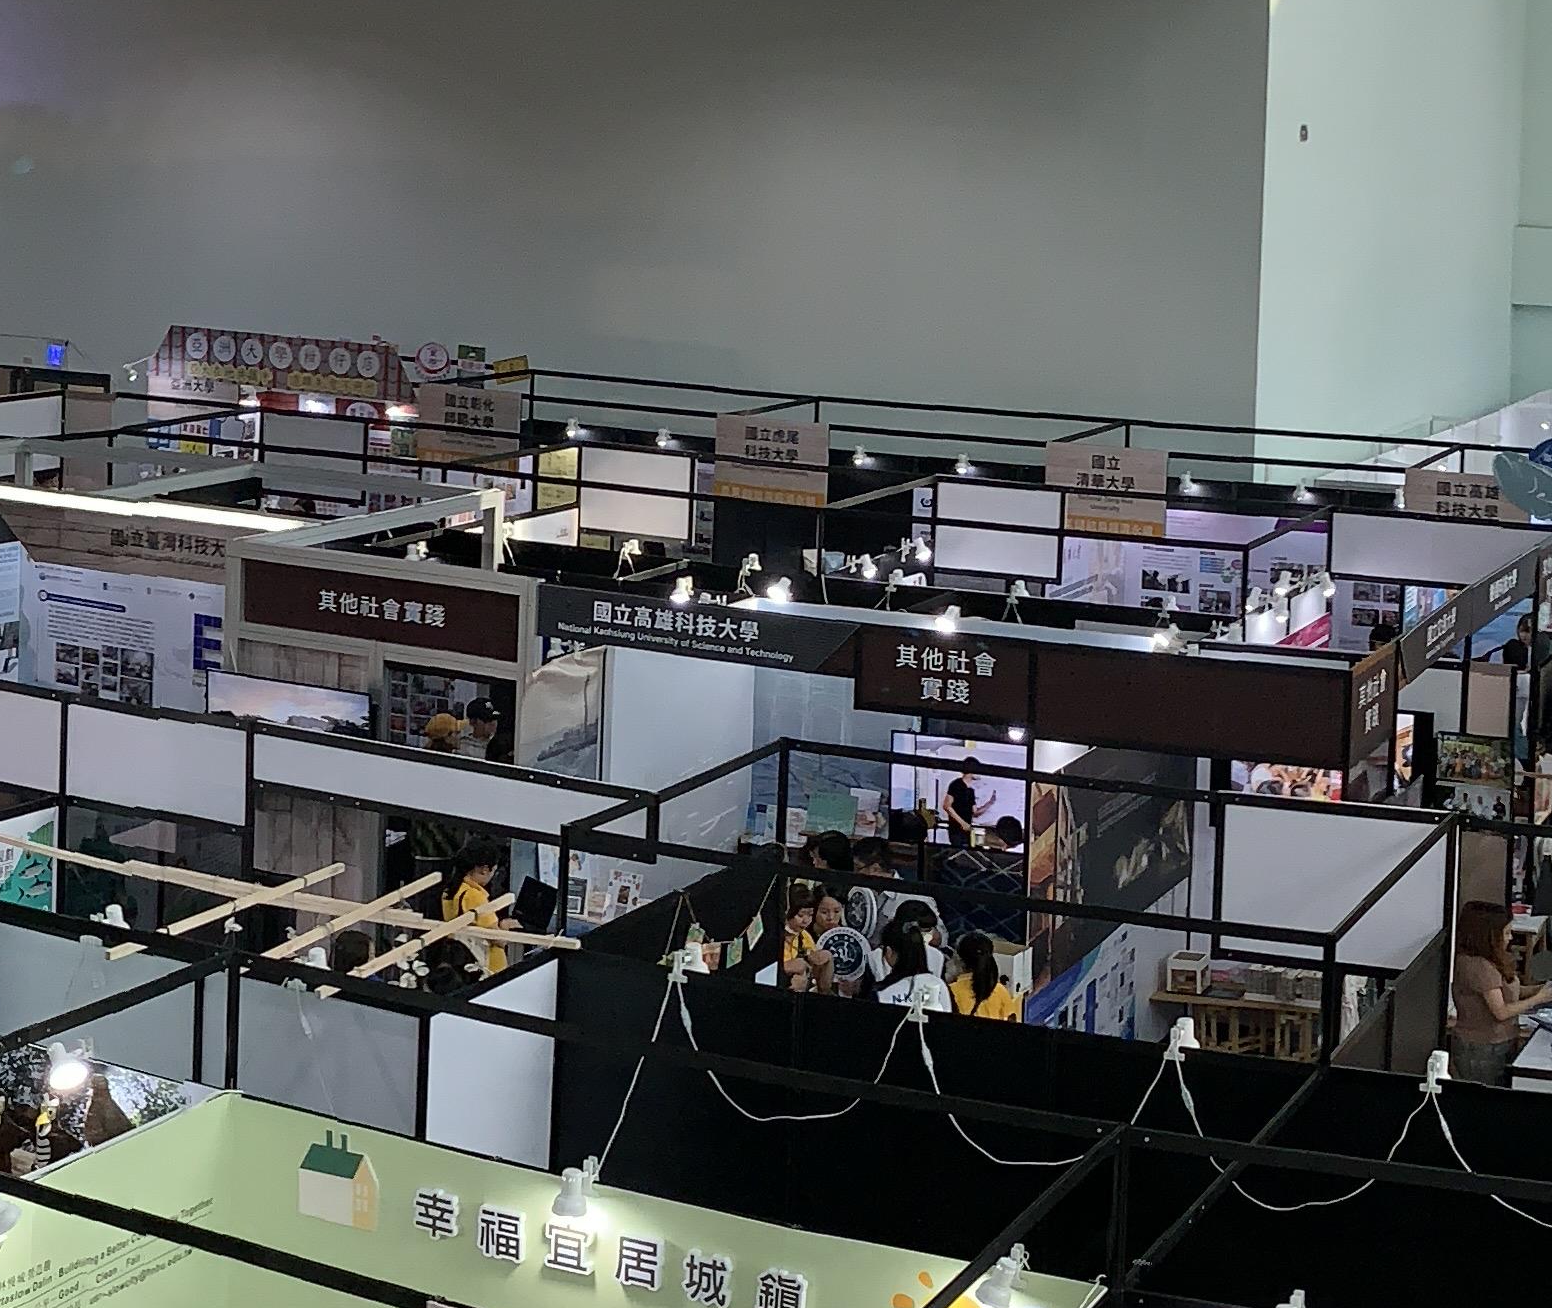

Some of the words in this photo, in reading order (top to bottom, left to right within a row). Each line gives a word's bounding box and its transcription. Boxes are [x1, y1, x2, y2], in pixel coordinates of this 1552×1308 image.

[744, 445, 799, 462] 科技大學
[1091, 455, 1121, 471] 國立
[1076, 472, 1135, 492] 清華大學
[317, 589, 446, 629] 其他社會實踐
[593, 600, 760, 643] 國立高雄科技大學
[557, 621, 592, 635] National
[637, 632, 679, 647] University
[726, 644, 744, 656] and
[744, 646, 794, 664] Technology
[895, 644, 998, 679] 其他社會
[920, 674, 972, 707] 實踐
[57, 1280, 80, 1300] Good
